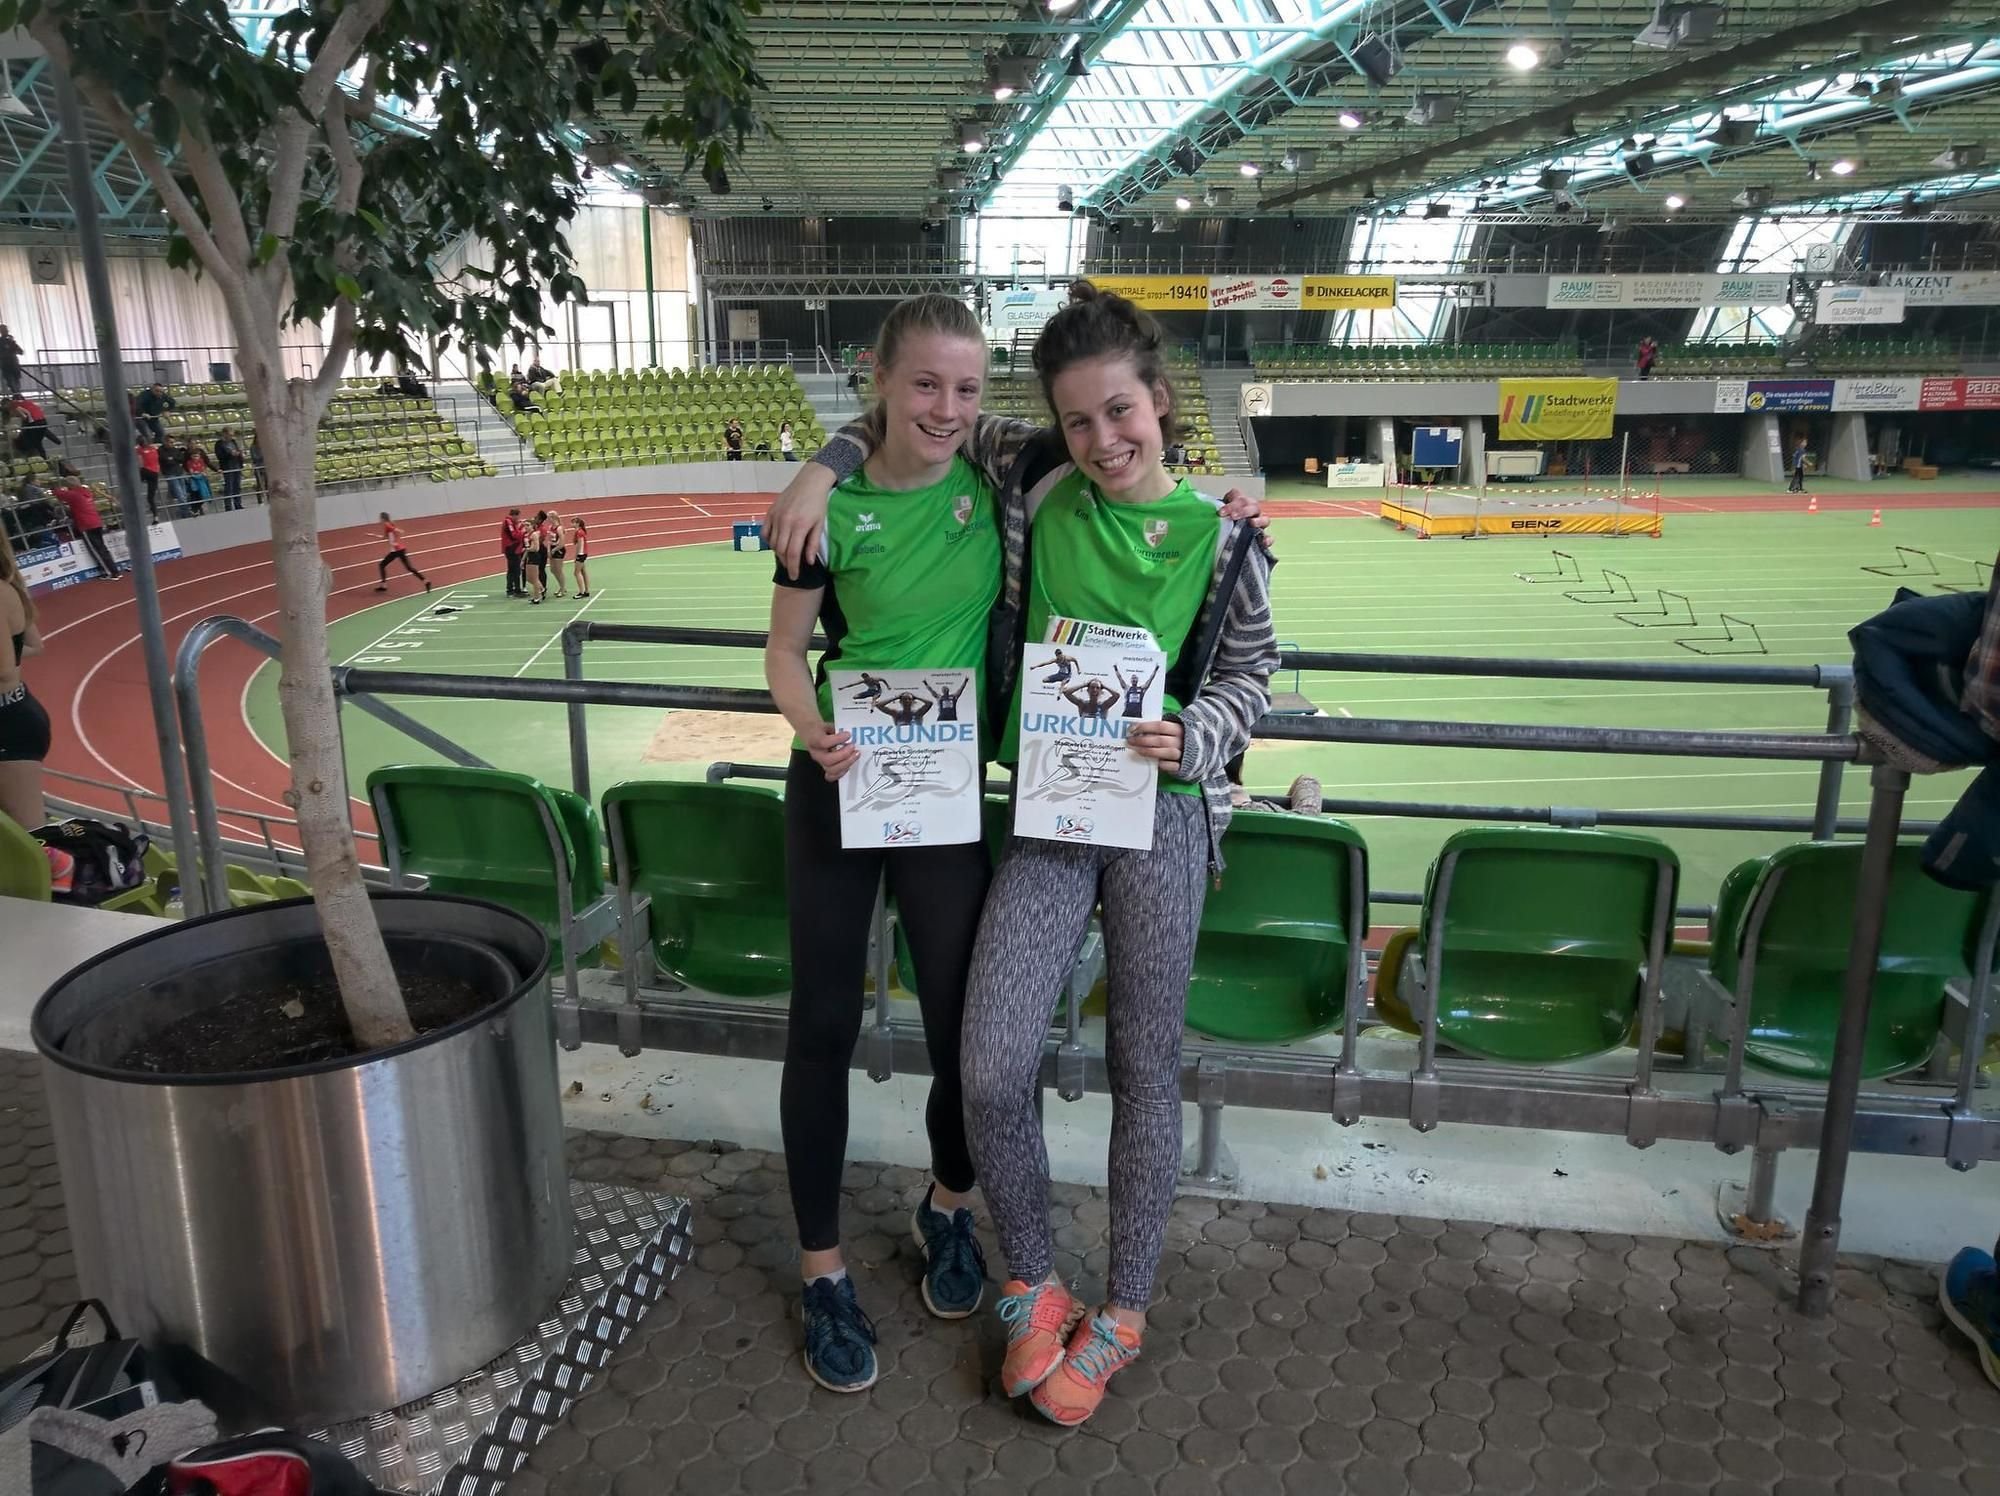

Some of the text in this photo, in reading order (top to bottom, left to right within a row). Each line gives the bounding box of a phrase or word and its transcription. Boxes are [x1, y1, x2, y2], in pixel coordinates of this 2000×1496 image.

[1560, 281, 1592, 291] RAUM
[1721, 281, 1753, 291] RAUM
[1894, 276, 1953, 288] AKZENT
[1210, 287, 1226, 298] Wir
[1317, 286, 1390, 298] DINKELACKER
[1007, 311, 1056, 321] GLASPALA
[1546, 394, 1614, 406] Stadtwerke
[1543, 408, 1585, 418] Sindelfingen
[855, 522, 881, 532] erima
[1511, 520, 1562, 529] BENZ
[1088, 624, 1149, 641] Stadtwerke
